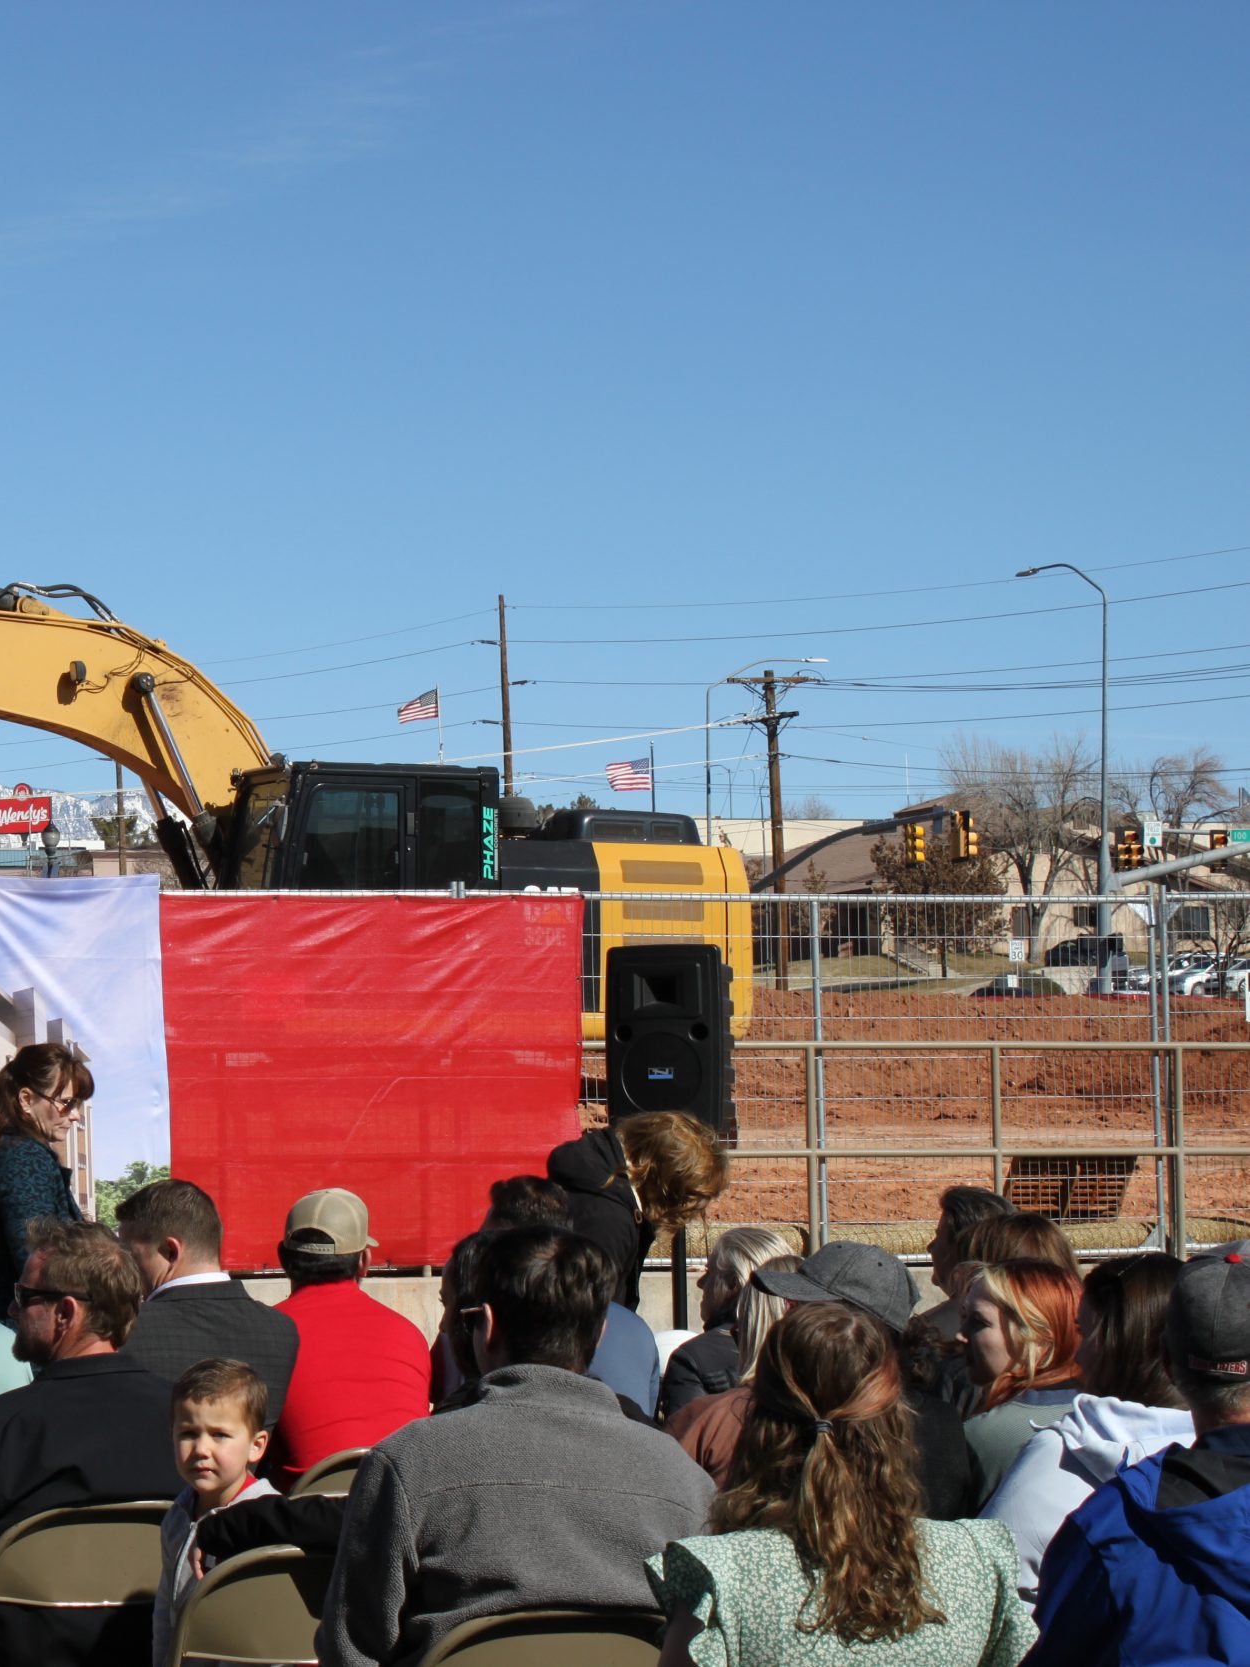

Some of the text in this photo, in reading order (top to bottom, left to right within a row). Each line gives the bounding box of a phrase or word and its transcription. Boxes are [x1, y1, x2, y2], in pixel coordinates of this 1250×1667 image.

[1233, 832, 1247, 840] 100
[483, 806, 494, 880] PHAZE
[1011, 950, 1024, 960] 30
